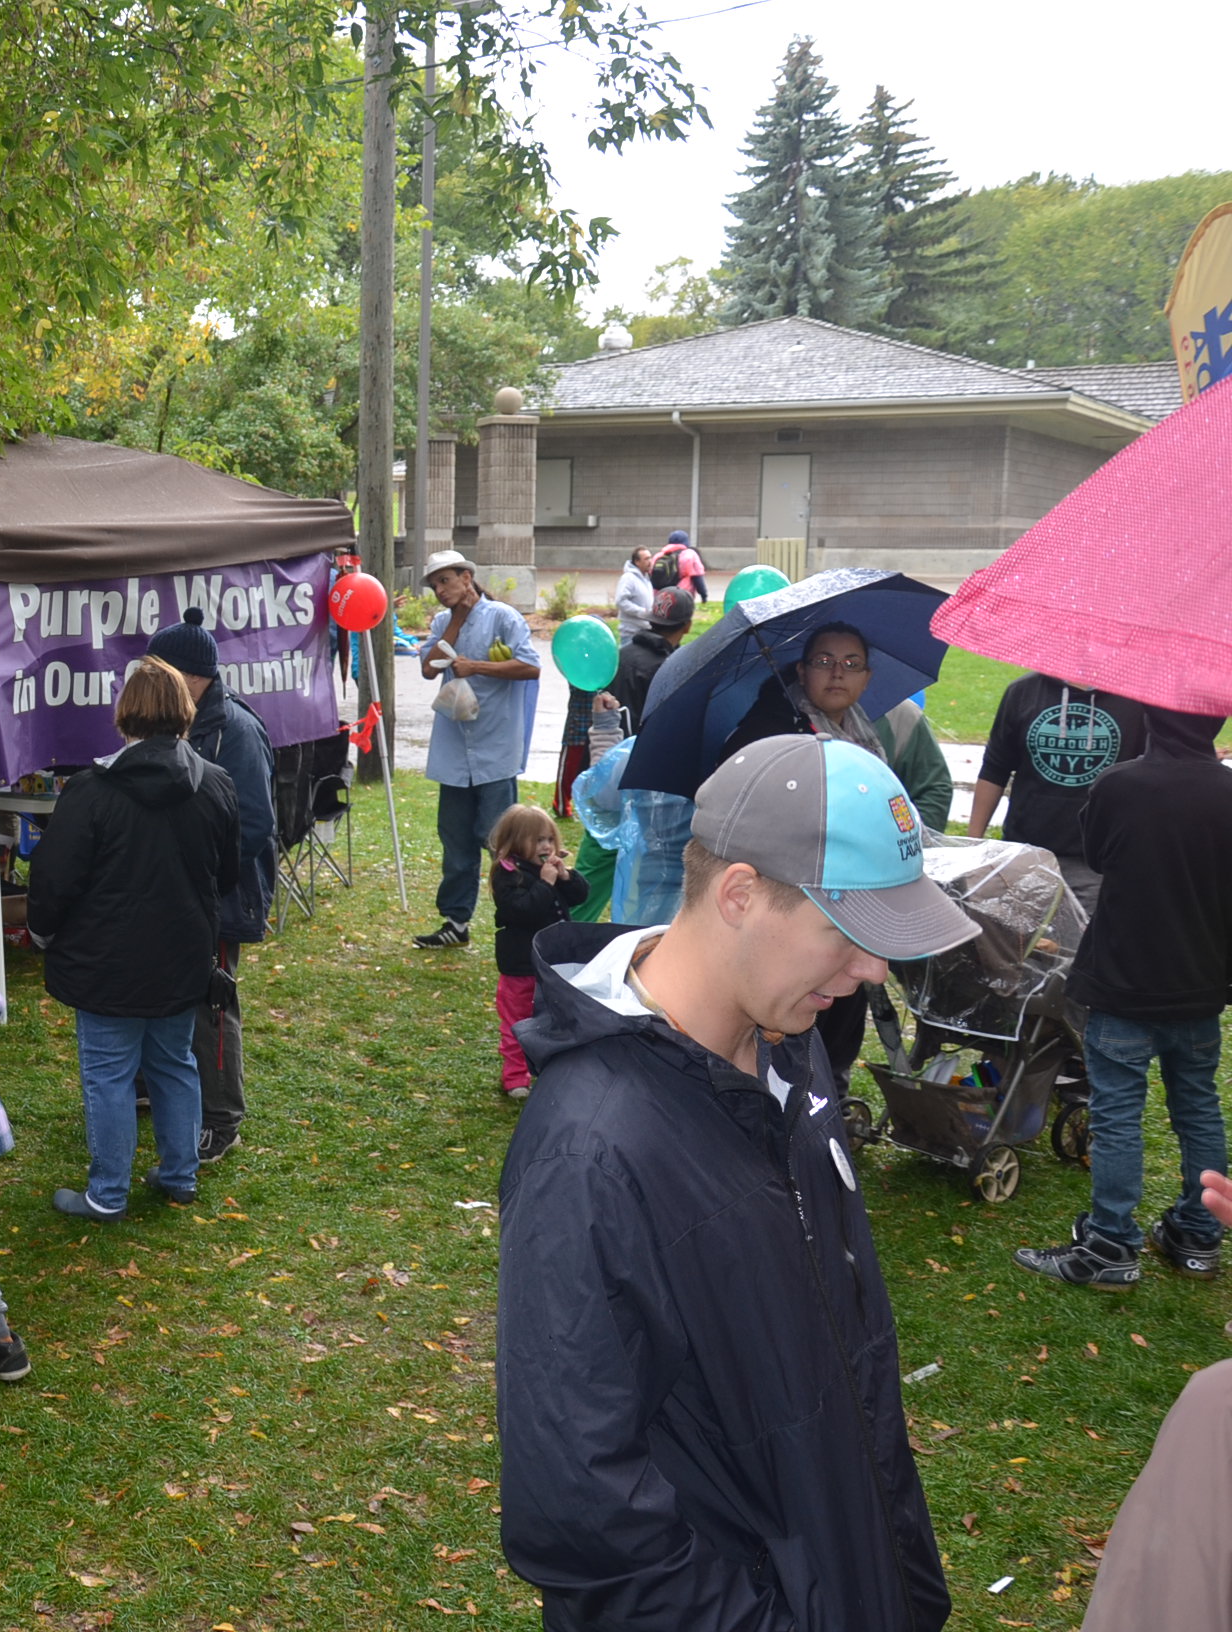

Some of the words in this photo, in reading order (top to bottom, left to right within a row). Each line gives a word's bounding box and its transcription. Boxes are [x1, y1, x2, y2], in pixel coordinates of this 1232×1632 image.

[8, 577, 160, 649] Purple
[173, 573, 316, 631] Works
[13, 668, 36, 714] in
[44, 661, 116, 707] Our
[1038, 735, 1108, 749] BOROUGH
[1049, 754, 1094, 773] NYC
